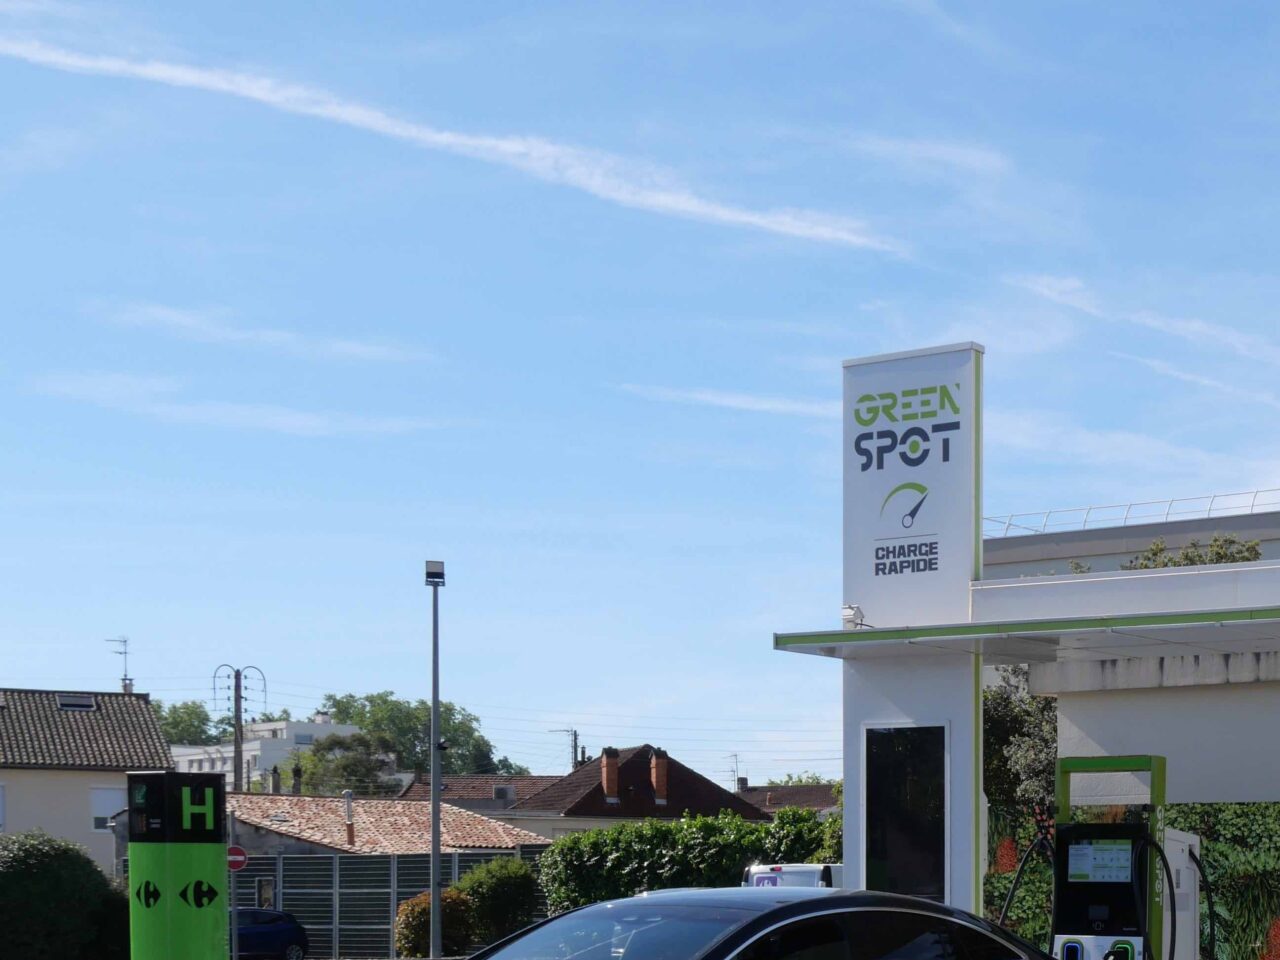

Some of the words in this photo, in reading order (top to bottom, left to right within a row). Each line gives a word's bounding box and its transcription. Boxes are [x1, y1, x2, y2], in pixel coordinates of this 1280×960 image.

[854, 383, 960, 427] GREEN
[854, 421, 960, 472] SPOT
[875, 542, 938, 560] CHARGE
[875, 557, 938, 576] RAPIDE
[182, 786, 214, 830] H
